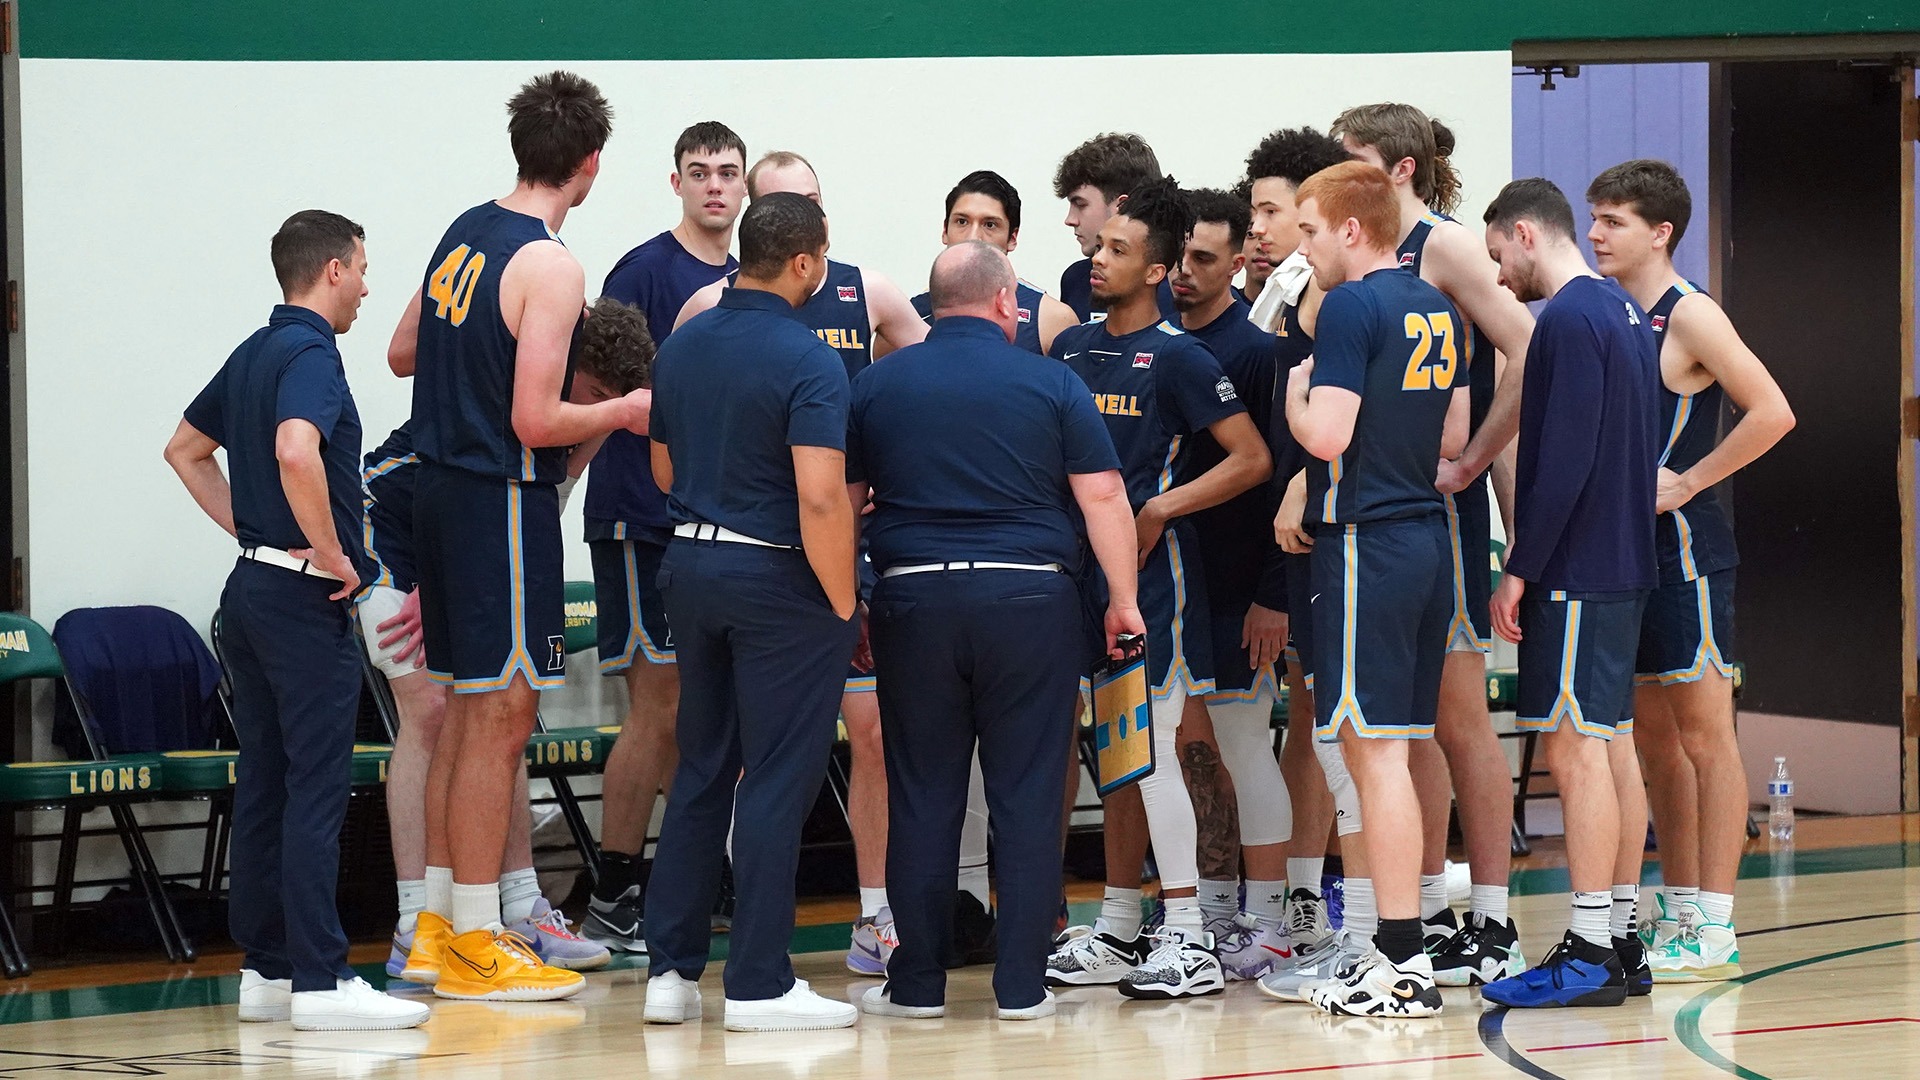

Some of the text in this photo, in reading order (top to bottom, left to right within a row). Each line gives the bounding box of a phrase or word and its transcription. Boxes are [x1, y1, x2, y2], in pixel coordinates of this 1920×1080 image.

[427, 243, 486, 328] 40
[1401, 311, 1458, 391] 23
[1092, 393, 1142, 416] NELL
[525, 739, 593, 766] IONS
[70, 766, 151, 794] LIONS
